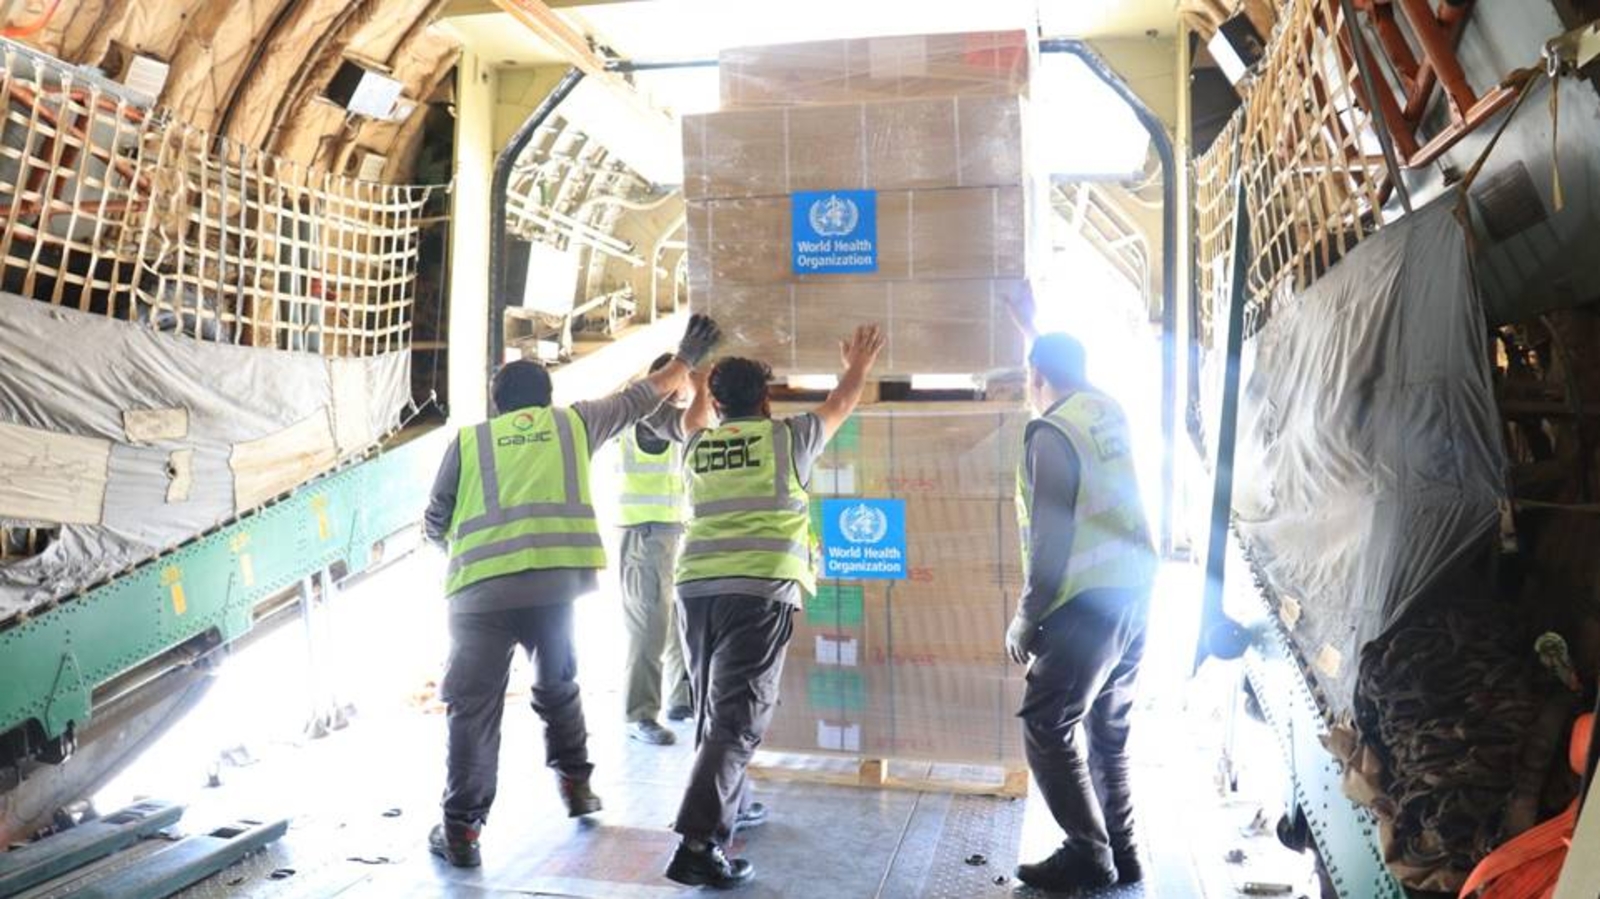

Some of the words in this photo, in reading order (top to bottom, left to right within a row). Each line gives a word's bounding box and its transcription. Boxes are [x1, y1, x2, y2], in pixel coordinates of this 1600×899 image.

[797, 240, 831, 252] World
[834, 239, 871, 252] Health
[797, 252, 872, 269] Organization
[828, 546, 861, 559] World
[864, 546, 901, 559] Health
[828, 559, 902, 574] Organization
